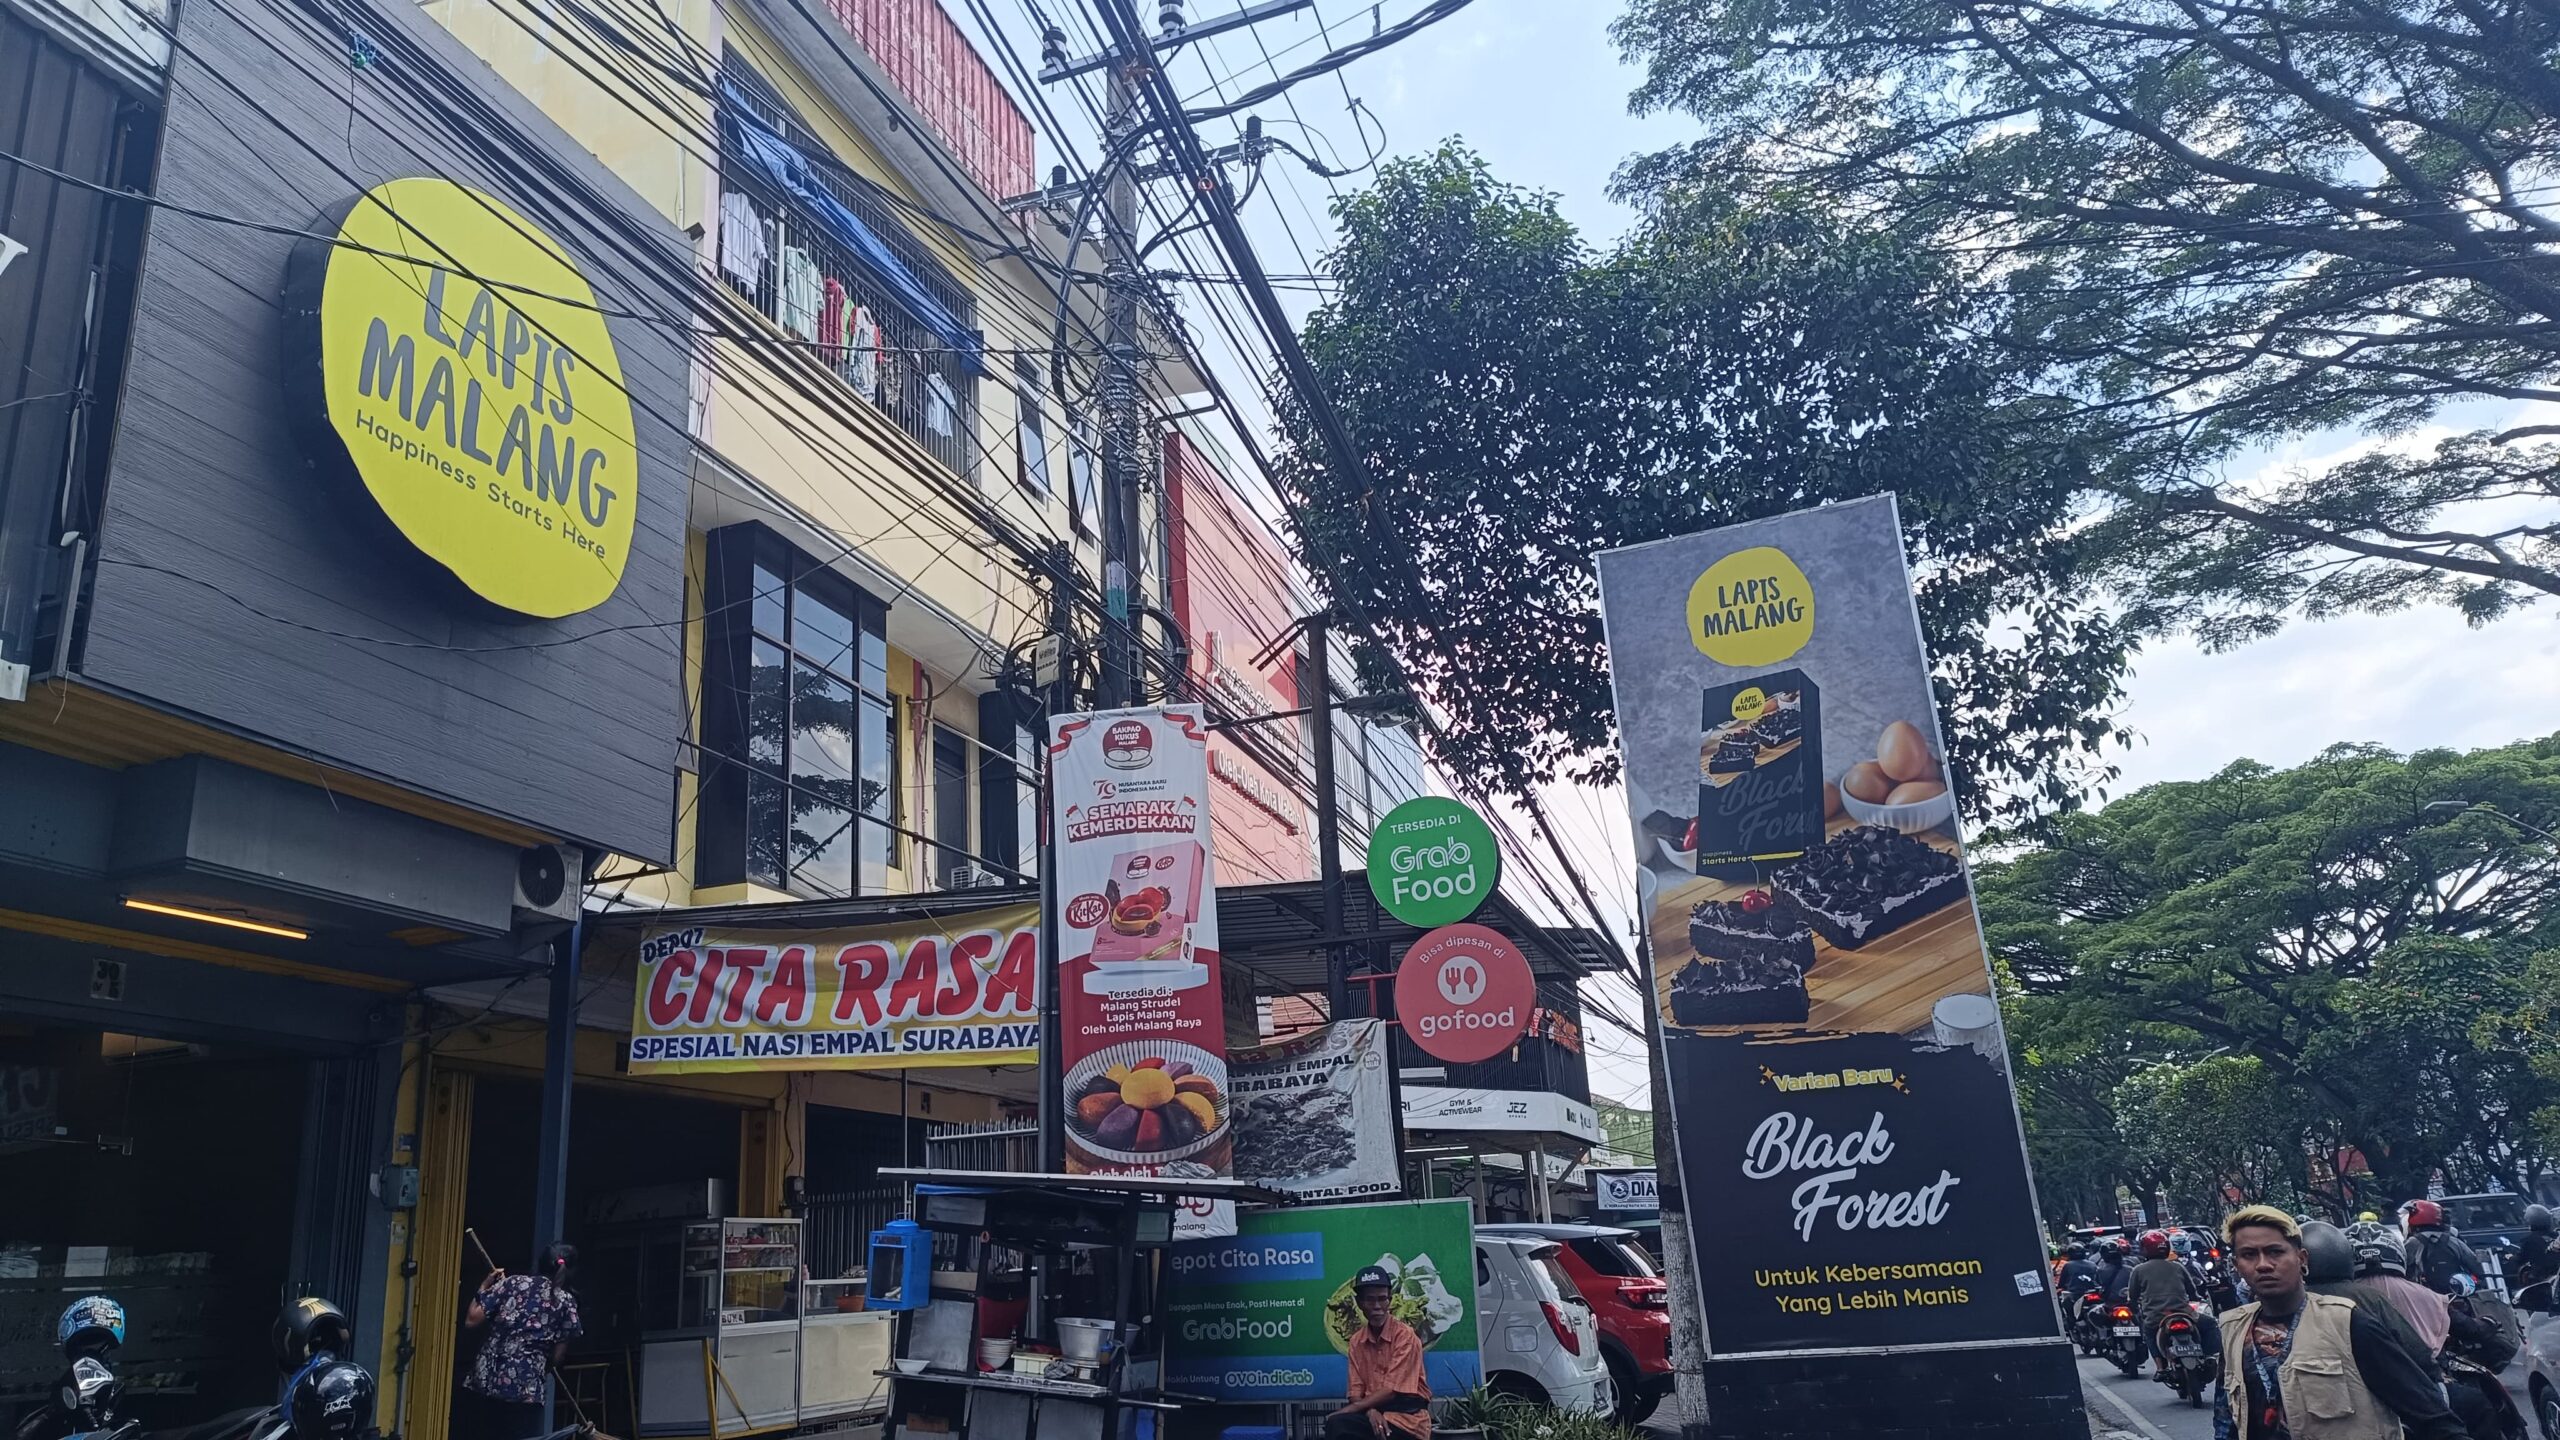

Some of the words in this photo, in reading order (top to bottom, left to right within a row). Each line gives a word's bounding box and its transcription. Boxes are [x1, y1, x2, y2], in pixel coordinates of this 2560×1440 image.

[424, 261, 575, 425] LAPIS
[359, 317, 616, 527] MALANG
[356, 409, 476, 489] Happiness
[488, 483, 553, 530] Starts
[563, 523, 606, 558] Here
[1718, 576, 1780, 608] LAPIS
[1703, 597, 1804, 637] MALANG
[1735, 701, 1762, 712] MALANG
[1740, 695, 1758, 705] LAPIS
[1112, 725, 1141, 734] BAKPAO
[1115, 733, 1139, 741] KUKUS
[1718, 761, 1805, 816] Black
[1088, 801, 1176, 820] SEMARAK
[1067, 815, 1195, 840] KEMERDEKAAN
[1390, 817, 1446, 834] TERSEDIA
[1449, 814, 1461, 824] DI
[1390, 836, 1471, 873] Grab
[1702, 857, 1726, 865] Starts
[1392, 864, 1476, 904] Food
[1073, 901, 1102, 921] KitKat
[643, 928, 704, 962] DEPOT
[1420, 943, 1443, 963] Bisa
[1446, 936, 1492, 951] dipesan
[1493, 948, 1507, 959] di
[649, 948, 806, 1026] CITA
[834, 932, 1036, 1026] RASA
[1100, 1001, 1139, 1012] Malang
[1141, 997, 1181, 1009] Strudel
[1108, 988, 1156, 999] Tersedia
[1156, 986, 1166, 996] di
[1082, 1025, 1106, 1034] Oleh
[1109, 1023, 1132, 1033] oleh
[1135, 1020, 1173, 1031] Malang
[1175, 1019, 1202, 1029] Raya
[1107, 1011, 1135, 1022] Lapis
[1137, 1010, 1176, 1019] Malang
[1420, 1007, 1514, 1037] gofood
[632, 1035, 735, 1059] SPESIAL
[743, 1034, 803, 1055] NASI
[811, 1031, 895, 1054] EMPAL
[904, 1024, 1041, 1052] SURABAYA
[1296, 1054, 1354, 1071] EMPAL
[1227, 1072, 1328, 1093] URABAYA
[1773, 1072, 1840, 1092] Varian
[1842, 1068, 1893, 1087] Baru
[1400, 1101, 1411, 1111] RI
[1439, 1107, 1482, 1116] ACTIVEWEAR
[1506, 1102, 1527, 1114] JEZ
[1742, 1111, 1895, 1179] Black
[1296, 1187, 1343, 1198] ENTAL
[1348, 1182, 1391, 1194] FOOD
[1631, 1181, 1658, 1196] DIA
[1792, 1168, 1960, 1242] Forest
[1171, 1252, 1216, 1274] epot
[1220, 1248, 1259, 1267] Cita
[1264, 1248, 1314, 1266] Rasa
[1754, 1266, 1819, 1287] Untuk
[1825, 1259, 1982, 1283] Kebersamaan
[1204, 1302, 1224, 1310] Menu
[1226, 1301, 1247, 1310] Enak,
[1249, 1300, 1268, 1308] Pasti
[1269, 1299, 1295, 1307] Hemat
[1297, 1298, 1305, 1306] di
[1775, 1295, 1831, 1315] Yang
[1838, 1290, 1897, 1310] Lebih
[1903, 1286, 1969, 1306] Manis
[1183, 1314, 1292, 1341] GrabFood
[1190, 1375, 1219, 1384] Untung
